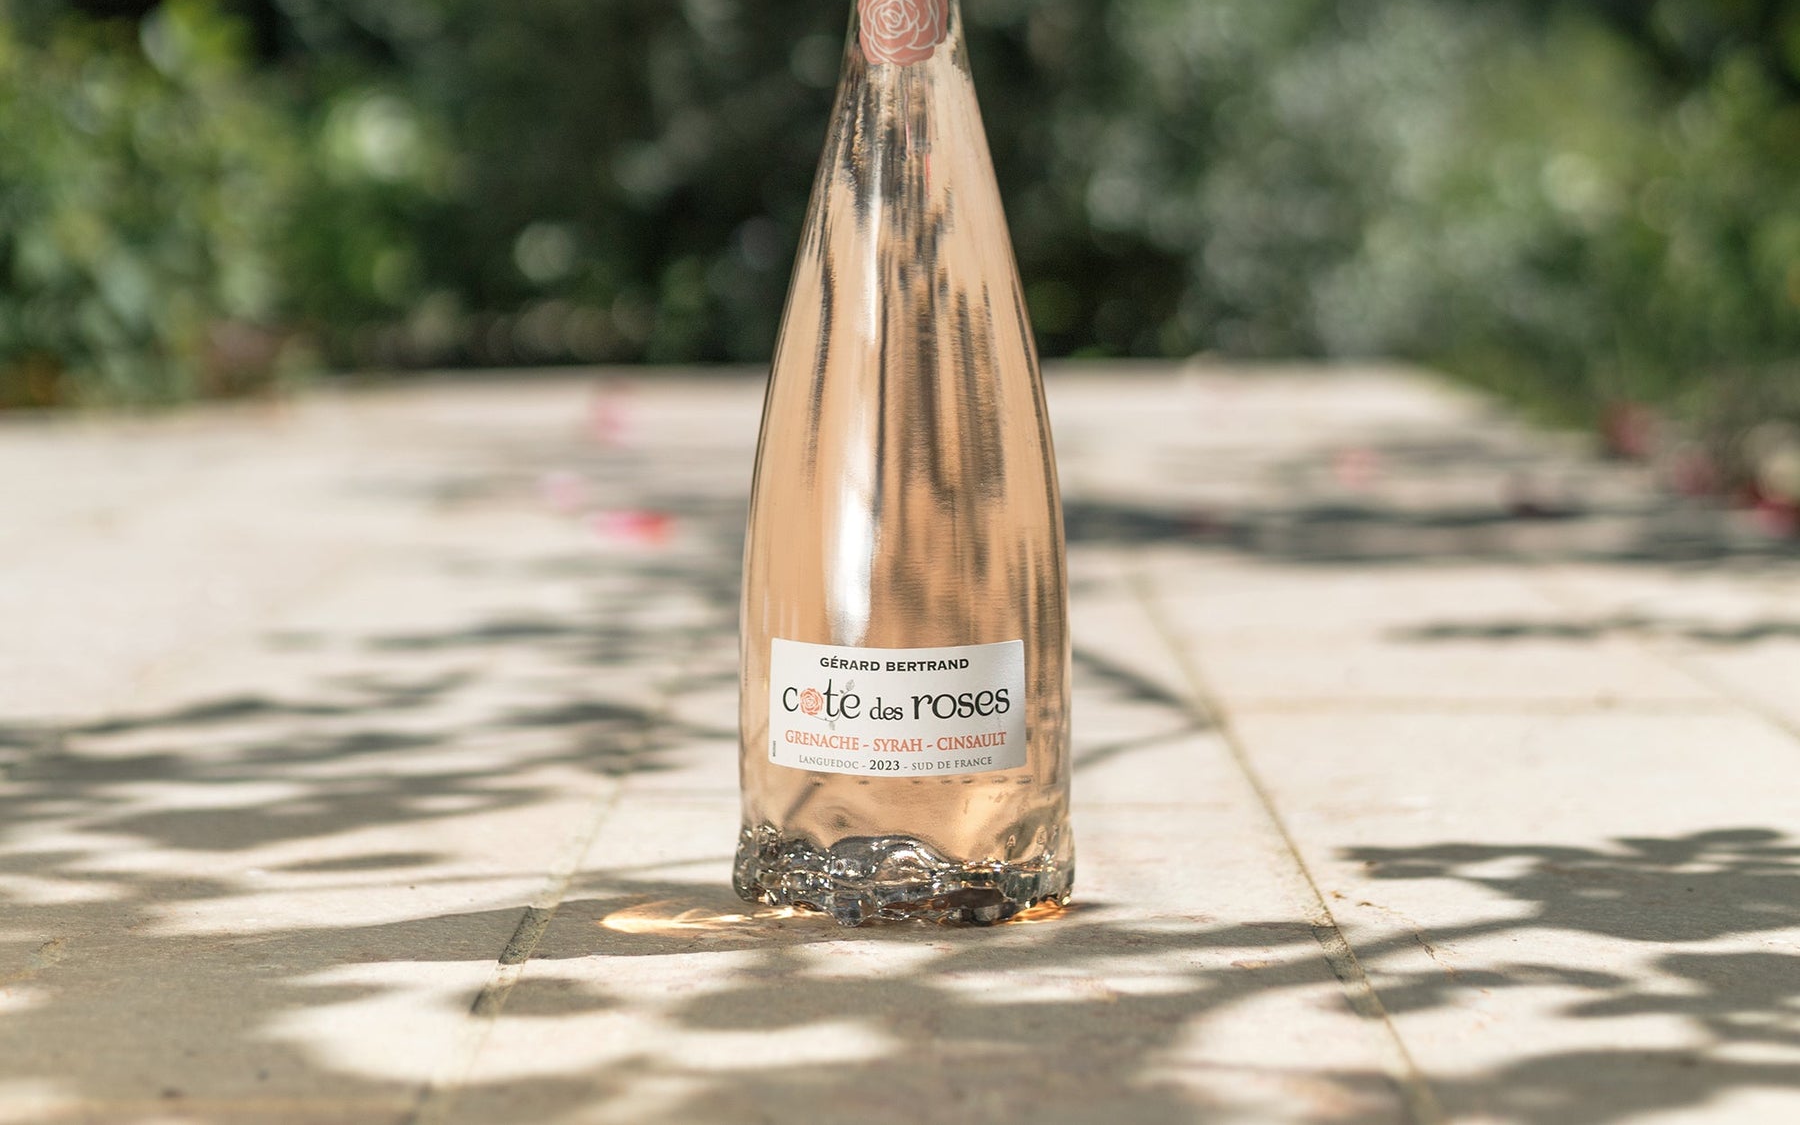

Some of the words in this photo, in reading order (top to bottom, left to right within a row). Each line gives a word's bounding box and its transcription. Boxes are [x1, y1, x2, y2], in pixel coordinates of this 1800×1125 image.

[820, 656, 880, 672] GÉRARD
[885, 658, 970, 672] BERTRAND
[869, 697, 904, 721] des
[911, 688, 1011, 720] roses
[785, 729, 859, 751] GRENACHE
[872, 737, 923, 752] SYRAH
[936, 731, 1007, 751] CINSAULT
[798, 754, 859, 770] LANGUEDOC
[869, 759, 900, 771] 2023
[911, 761, 934, 771] SUD
[937, 759, 952, 770] DE
[955, 756, 993, 768] FRANCE
